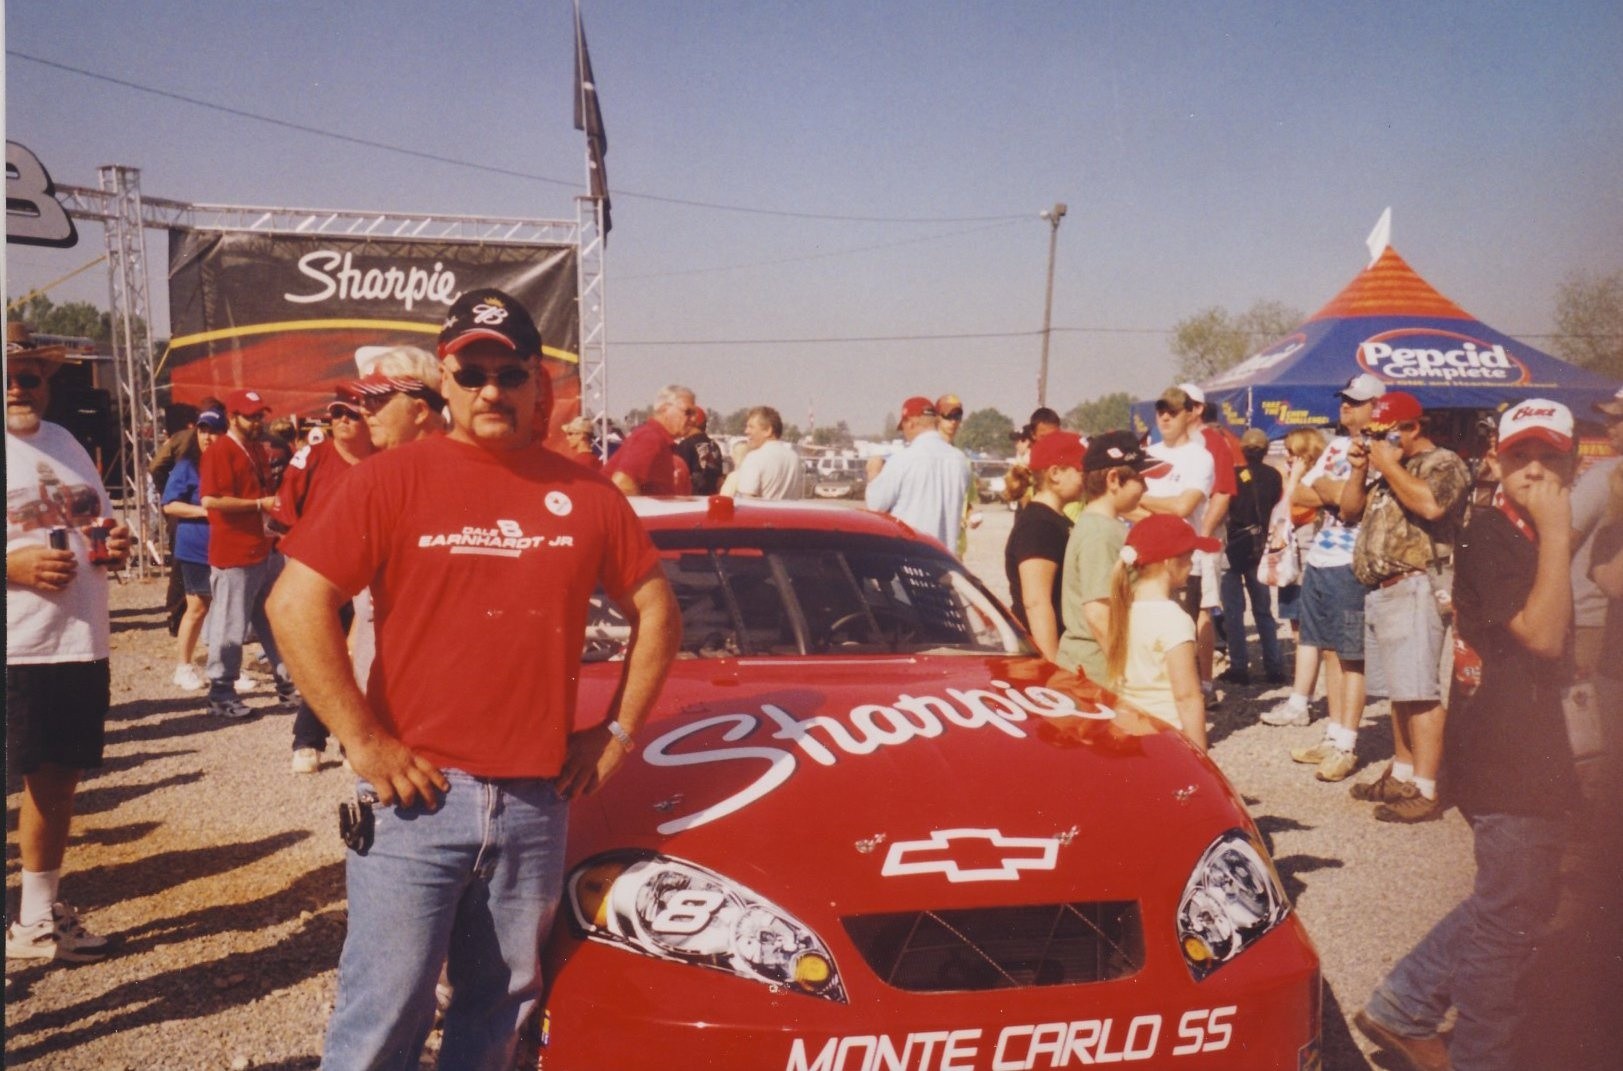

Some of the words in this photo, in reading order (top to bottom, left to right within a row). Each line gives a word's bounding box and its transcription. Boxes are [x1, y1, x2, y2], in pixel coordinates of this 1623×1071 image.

[284, 250, 461, 311] Sharpie
[1360, 342, 1511, 369] Pepcid
[1383, 362, 1507, 380] Complete
[418, 534, 545, 549] EARNHARDT
[548, 536, 574, 547] JR
[462, 526, 499, 536] DALE
[642, 680, 1117, 835] Sharpie
[651, 889, 726, 935] 8
[785, 1028, 983, 1071] MONTE
[991, 1013, 1162, 1071] CARLO
[1172, 1005, 1238, 1056] SS
